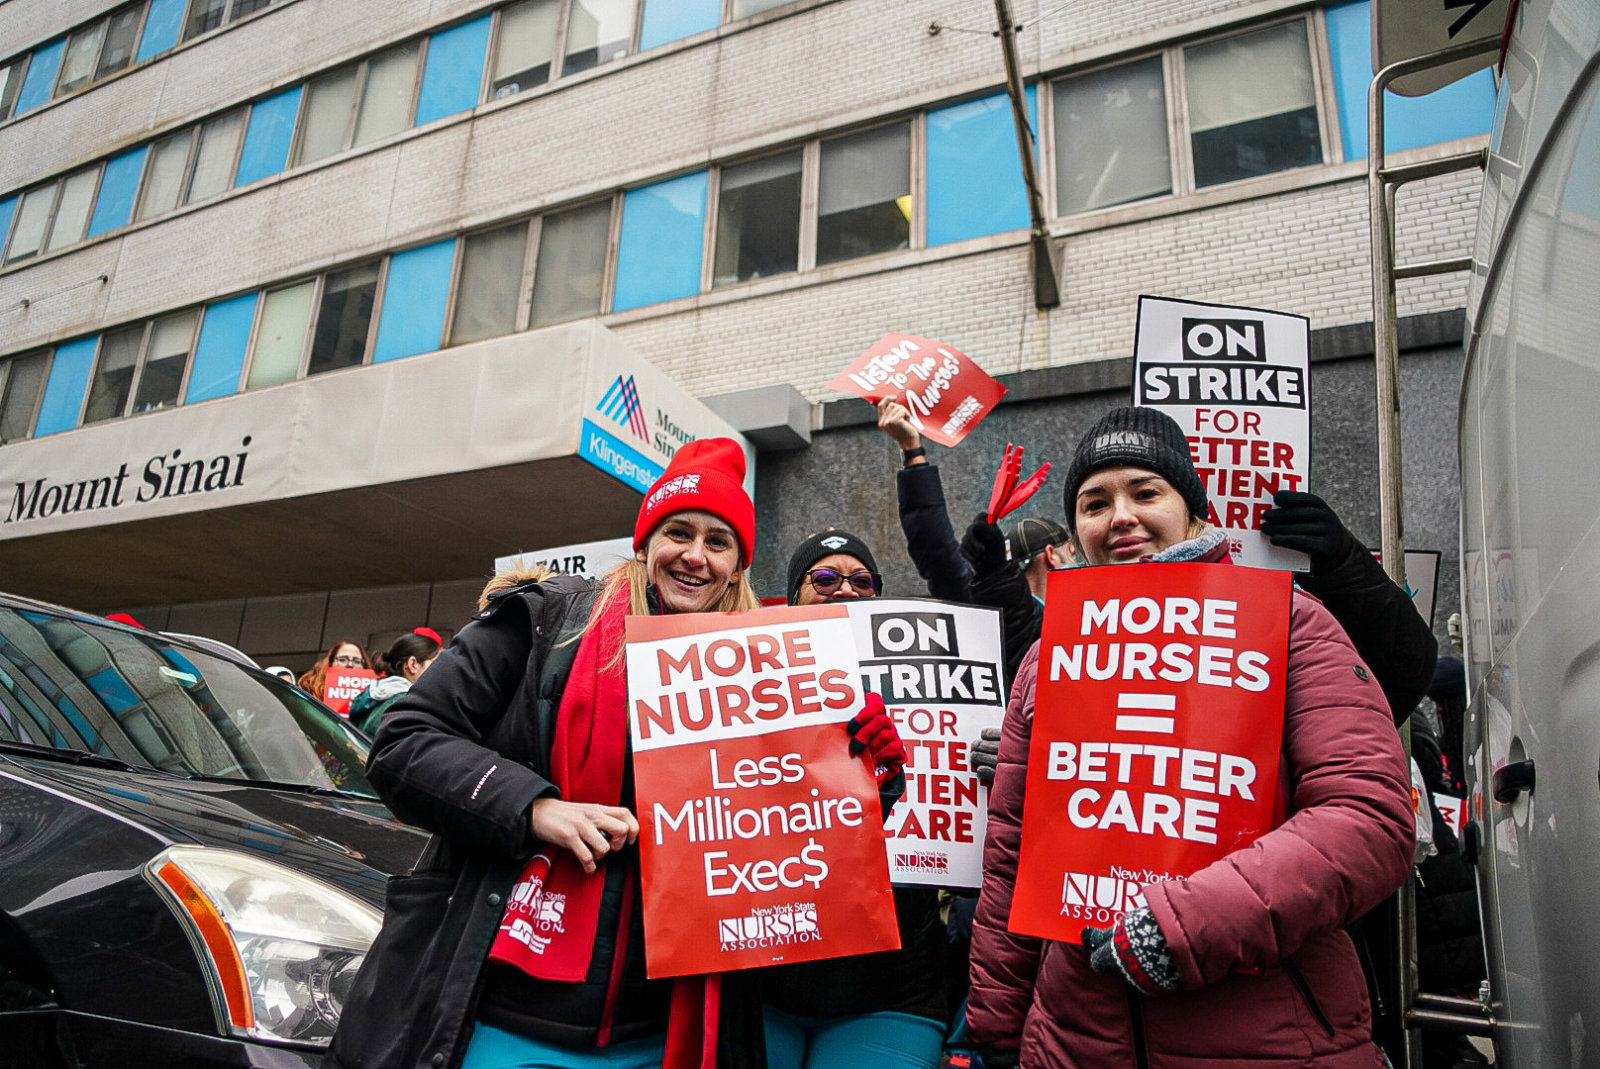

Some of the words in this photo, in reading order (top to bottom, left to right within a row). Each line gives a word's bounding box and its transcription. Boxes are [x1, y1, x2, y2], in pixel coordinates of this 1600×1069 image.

[1187, 323, 1257, 358] ON
[1145, 366, 1301, 404] STRIKE
[1096, 430, 1149, 449] DKNY
[1195, 408, 1262, 436] FOR
[590, 432, 659, 488] Klingenste
[654, 433, 675, 459] Sin
[1186, 436, 1294, 470] ETTER
[4, 463, 129, 524] Mount
[135, 435, 252, 503] Sinai
[1194, 467, 1302, 498] TIENT
[1207, 500, 1272, 531] ARE
[877, 617, 950, 652] ON
[1080, 597, 1238, 640] MORE
[656, 629, 816, 686] MORE
[1049, 642, 1271, 692] NURSES
[328, 687, 360, 700] NUR
[338, 675, 372, 689] MOR
[859, 663, 997, 701] TRIKE
[634, 669, 855, 740] NURSES
[889, 708, 958, 737] FOR
[709, 749, 804, 789] Less
[902, 739, 976, 773] TTE
[1047, 742, 1257, 801] BETTER
[898, 773, 994, 809] TIEN
[653, 788, 863, 846] Millionaire
[1067, 788, 1220, 845] CARE
[704, 838, 829, 897] Exec$
[895, 853, 949, 869] NURSES
[1110, 865, 1141, 881] New
[718, 910, 818, 943] NURSES
[751, 907, 773, 917] New
[773, 903, 794, 914] York
[794, 902, 816, 912] State
